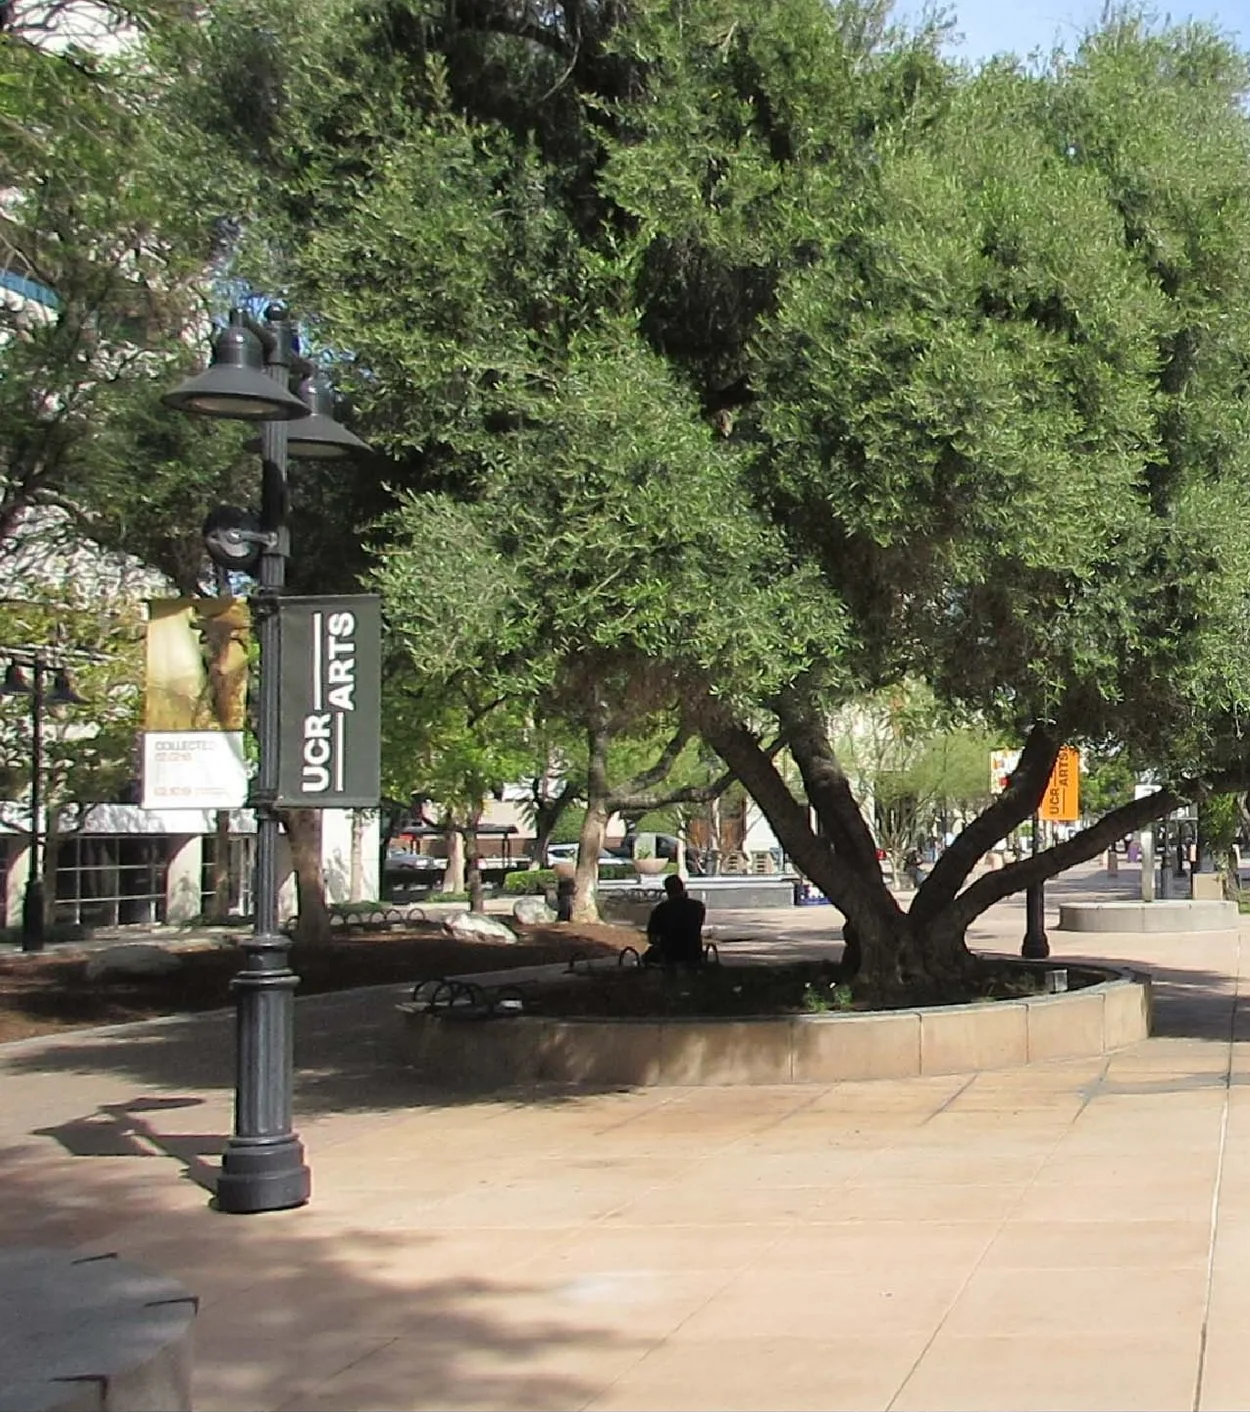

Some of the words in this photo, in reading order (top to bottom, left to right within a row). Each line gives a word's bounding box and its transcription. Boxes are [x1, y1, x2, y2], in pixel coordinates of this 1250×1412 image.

[328, 611, 355, 711] ARTS
[302, 713, 331, 792] UCR
[1058, 752, 1069, 786] ARTS
[1049, 787, 1060, 814] UCR
